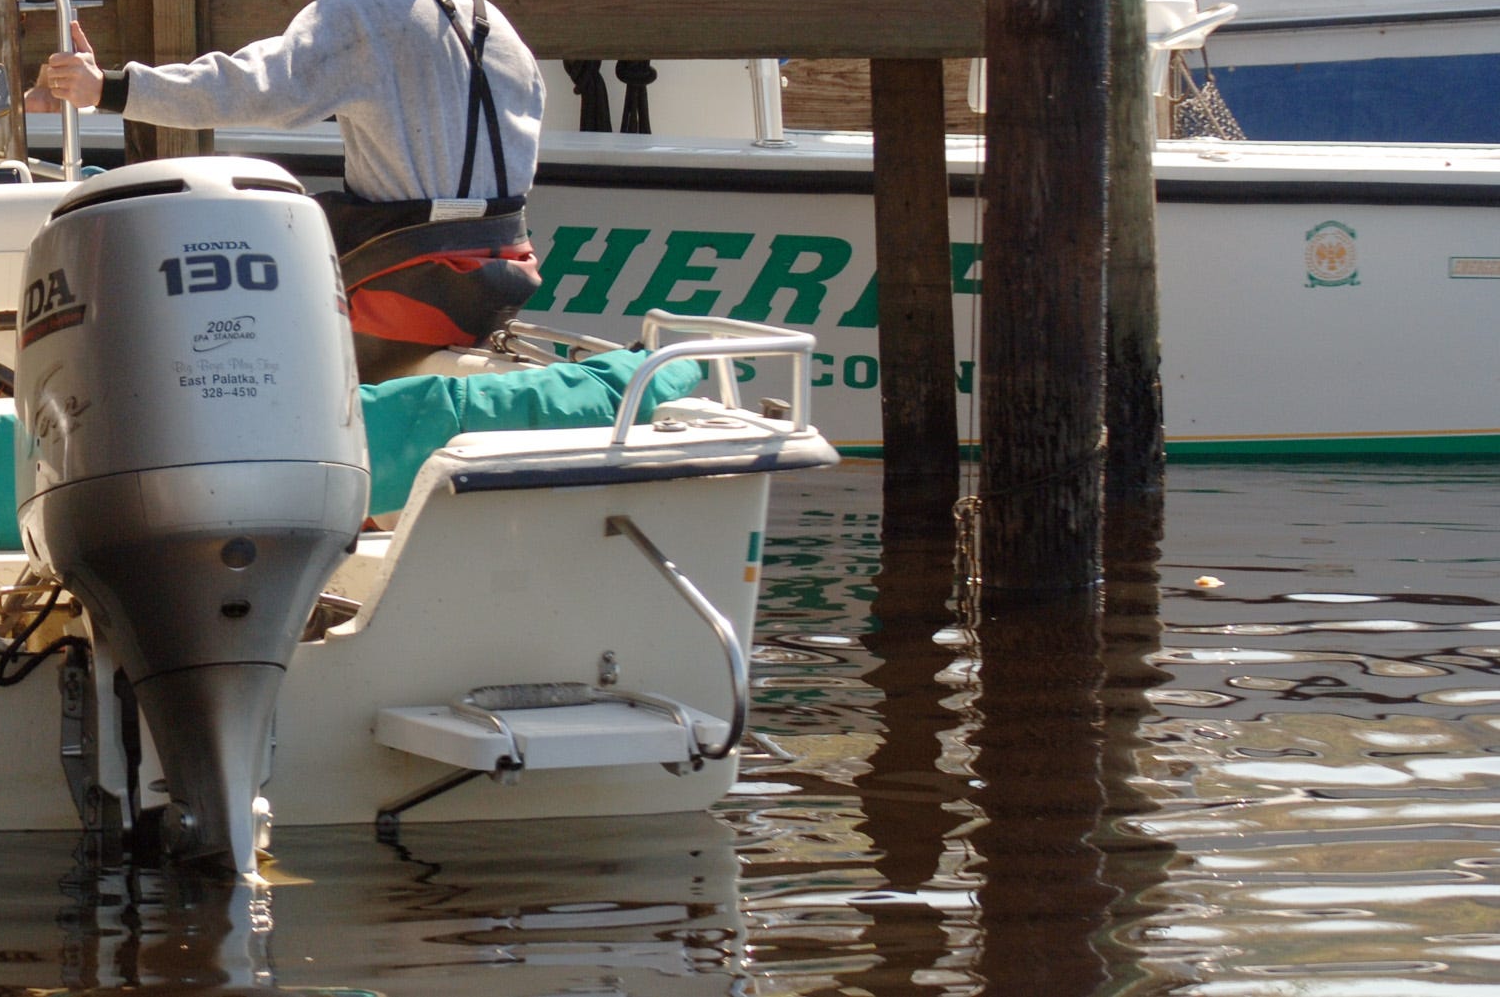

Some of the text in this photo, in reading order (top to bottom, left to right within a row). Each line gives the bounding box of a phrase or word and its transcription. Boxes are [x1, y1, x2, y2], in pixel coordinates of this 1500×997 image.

[182, 241, 252, 252] HONDA
[158, 253, 279, 297] 130
[206, 320, 242, 333] 2006
[193, 332, 256, 342] EPA STANDARD
[179, 376, 206, 387] East
[212, 374, 259, 385] Palatka,
[201, 387, 258, 399] 328-4510
